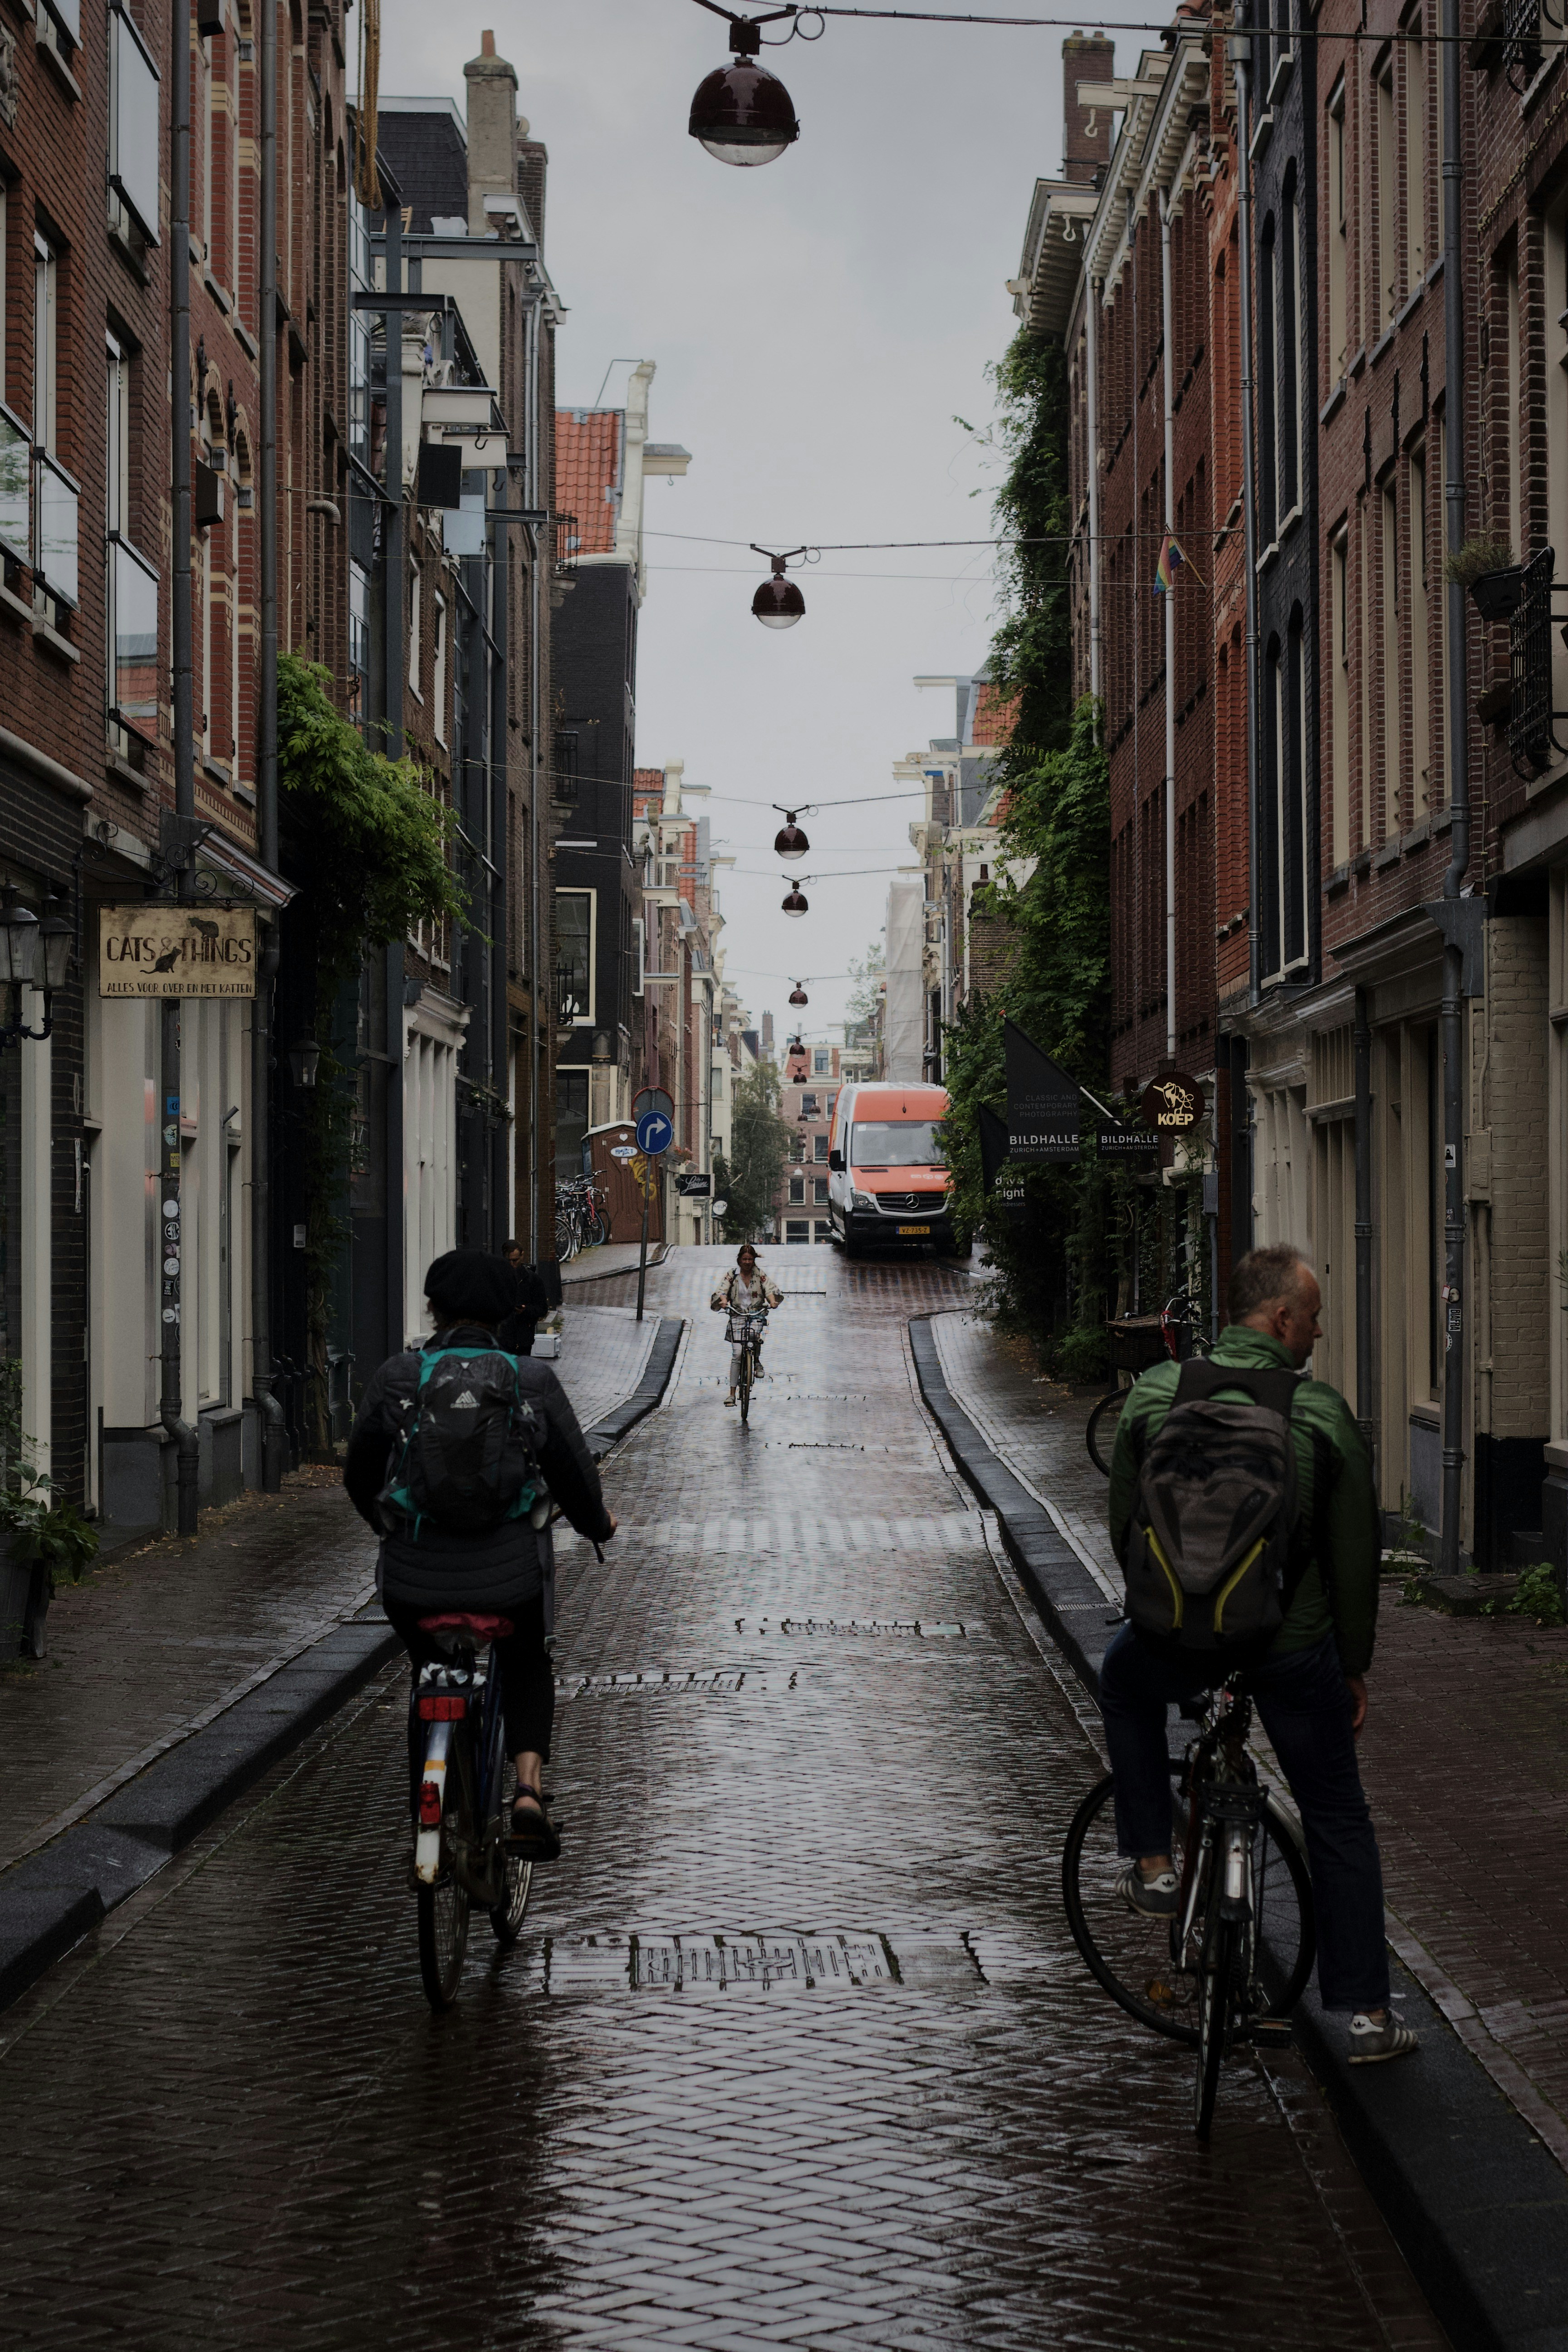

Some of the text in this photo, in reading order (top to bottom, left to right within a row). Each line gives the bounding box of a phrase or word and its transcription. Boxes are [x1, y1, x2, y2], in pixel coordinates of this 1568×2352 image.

[107, 937, 156, 962] CATS
[179, 937, 251, 963] THINGS
[108, 983, 134, 992] ALLES
[163, 984, 184, 993] OVER
[187, 984, 198, 993] EN
[201, 984, 216, 993] MET
[220, 984, 252, 993] KATTEN
[1158, 1113, 1194, 1126] KOEP
[1009, 1135, 1079, 1145] BILDHALLE
[1101, 1135, 1158, 1143] BILDHALLE
[1450, 1309, 1460, 1331] BIAFRA
